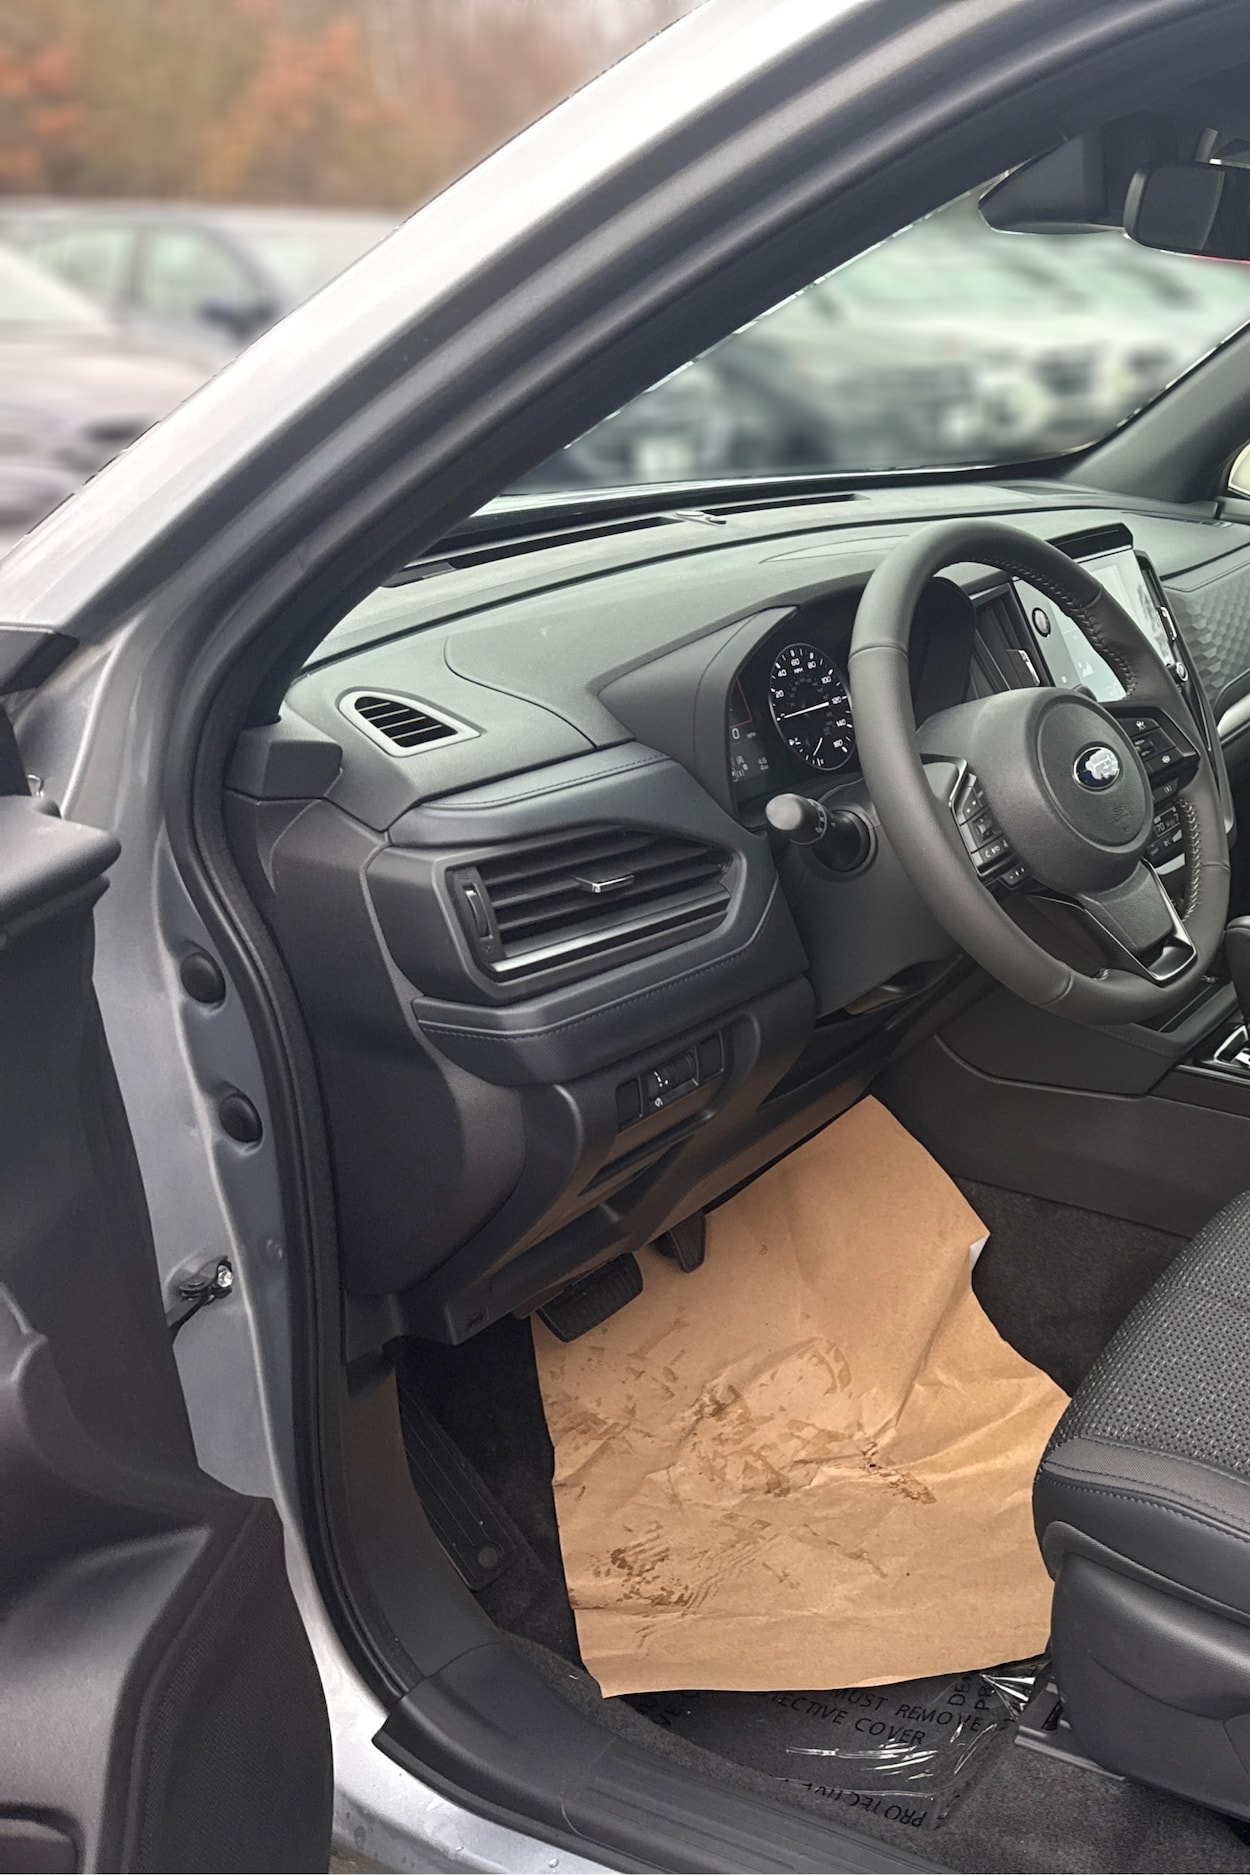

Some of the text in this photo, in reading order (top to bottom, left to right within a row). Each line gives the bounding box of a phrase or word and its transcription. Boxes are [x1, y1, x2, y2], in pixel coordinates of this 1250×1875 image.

[791, 658, 800, 666] 60
[807, 661, 816, 669] 80
[777, 669, 787, 677] 40
[821, 676, 832, 684] 100
[775, 690, 784, 698] 20
[732, 728, 740, 739] 0
[895, 1704, 984, 1732] REMOVE
[854, 1717, 926, 1746] COVER
